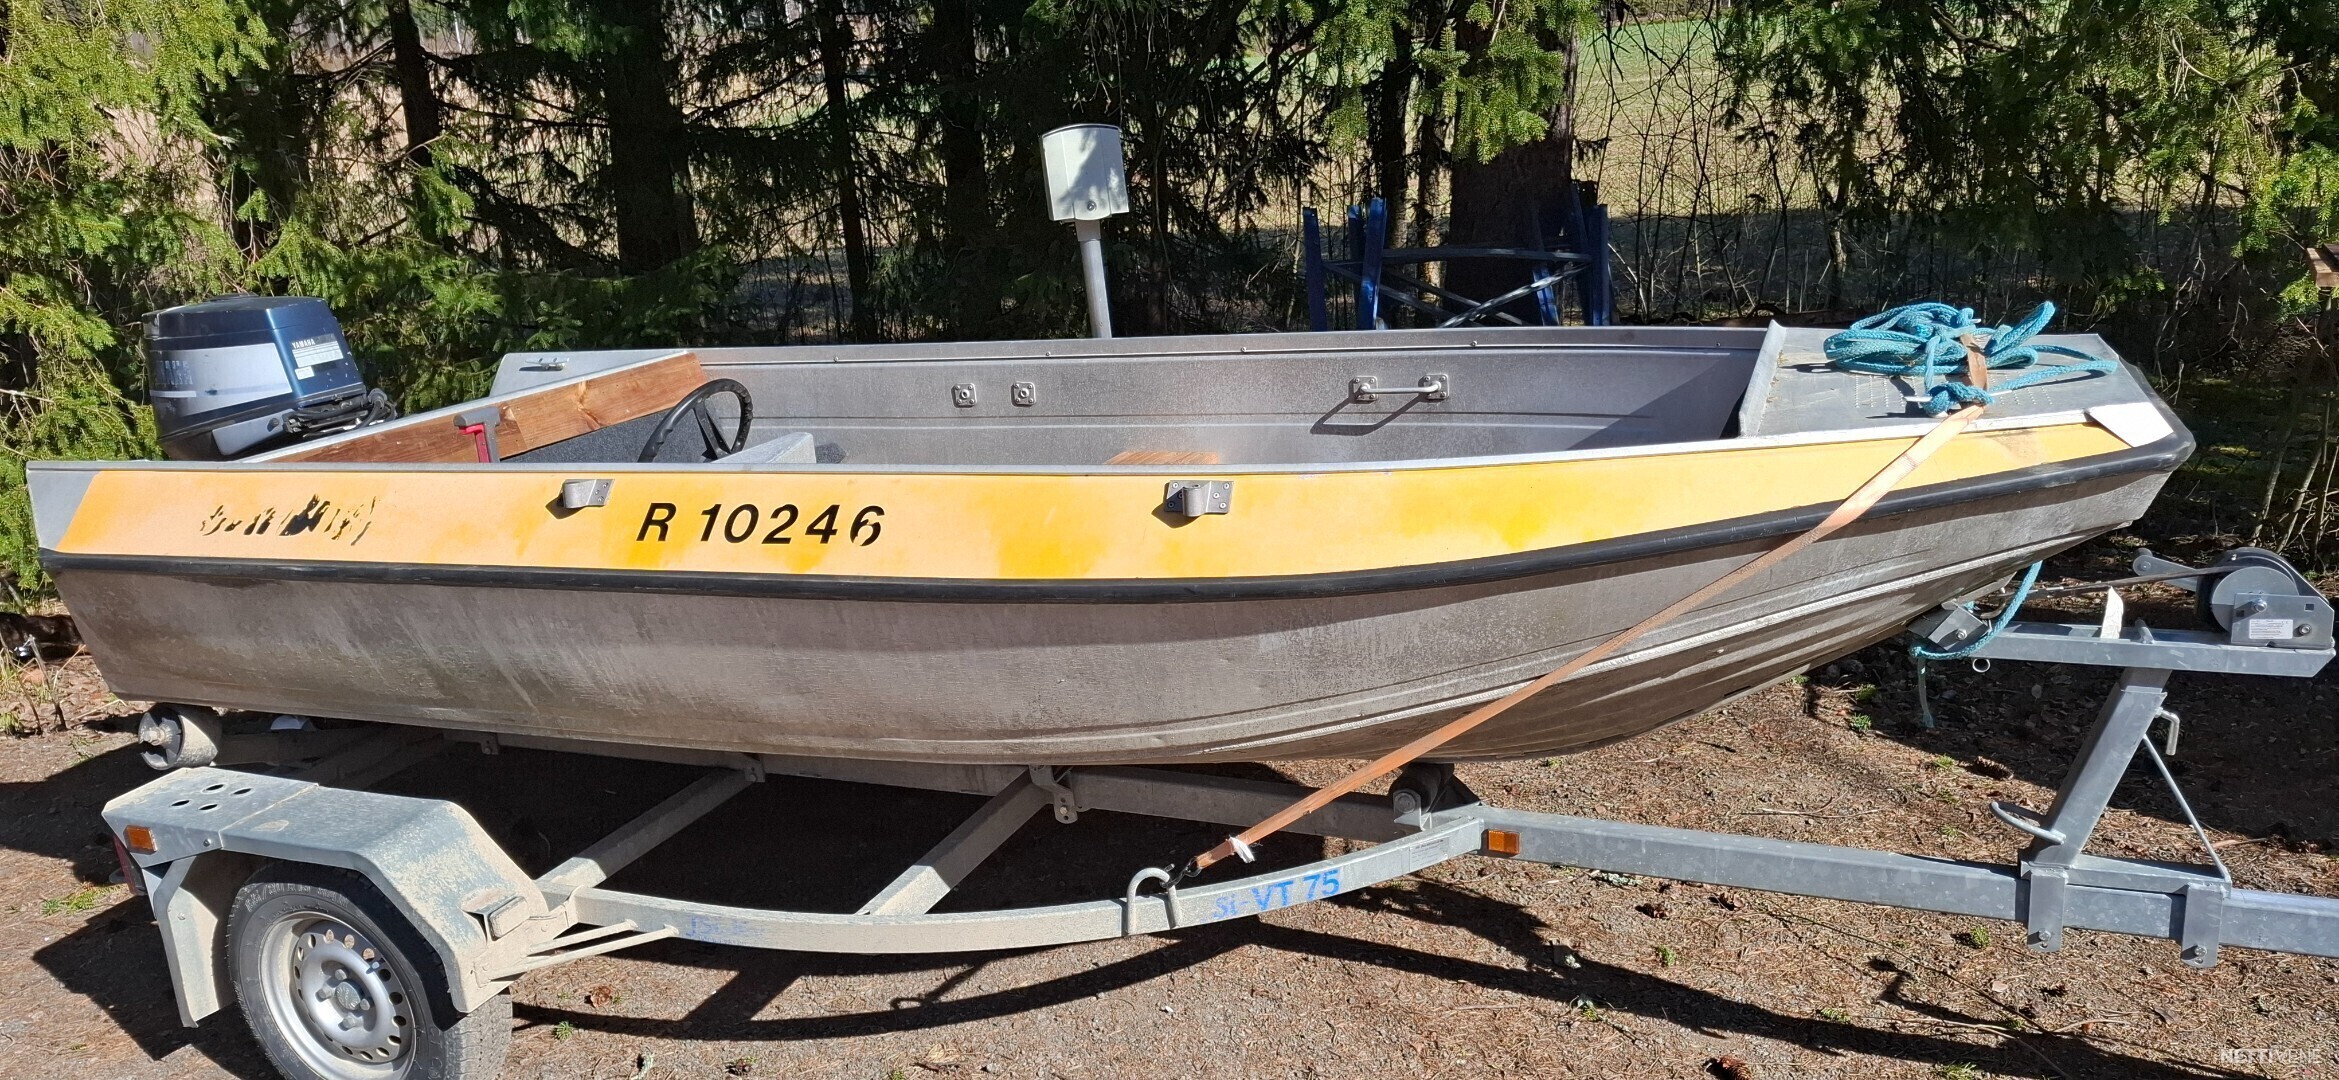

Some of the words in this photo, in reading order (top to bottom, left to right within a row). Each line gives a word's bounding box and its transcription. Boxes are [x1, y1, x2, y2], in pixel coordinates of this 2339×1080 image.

[291, 338, 316, 349] YAMAHA
[636, 502, 677, 542] R
[700, 503, 885, 547] 10246
[1303, 869, 1341, 899] 75
